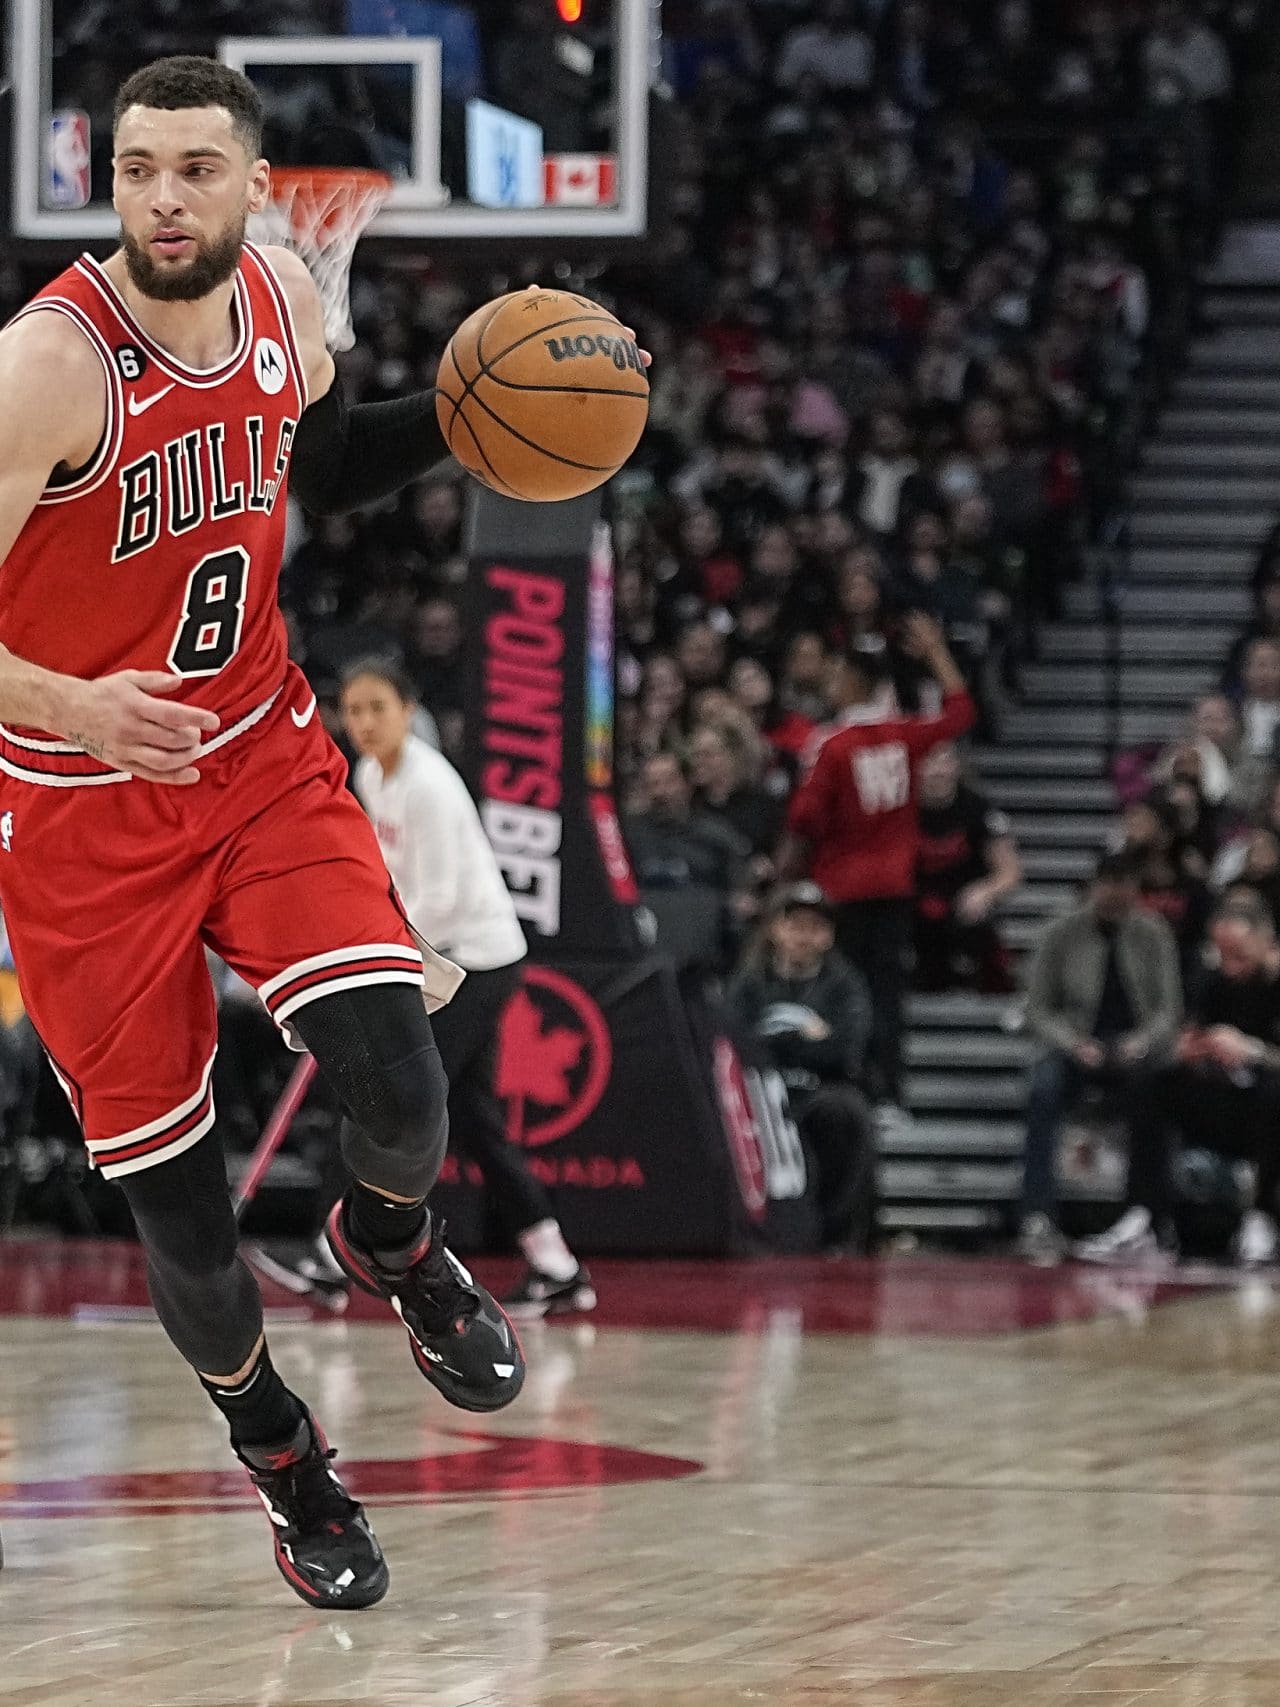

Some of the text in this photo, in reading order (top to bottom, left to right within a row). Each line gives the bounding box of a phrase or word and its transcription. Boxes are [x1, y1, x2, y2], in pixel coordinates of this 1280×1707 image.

[118, 348, 140, 379] 6
[111, 415, 297, 565] BULLS
[166, 544, 252, 680] 8
[482, 566, 565, 938] POINTSBET
